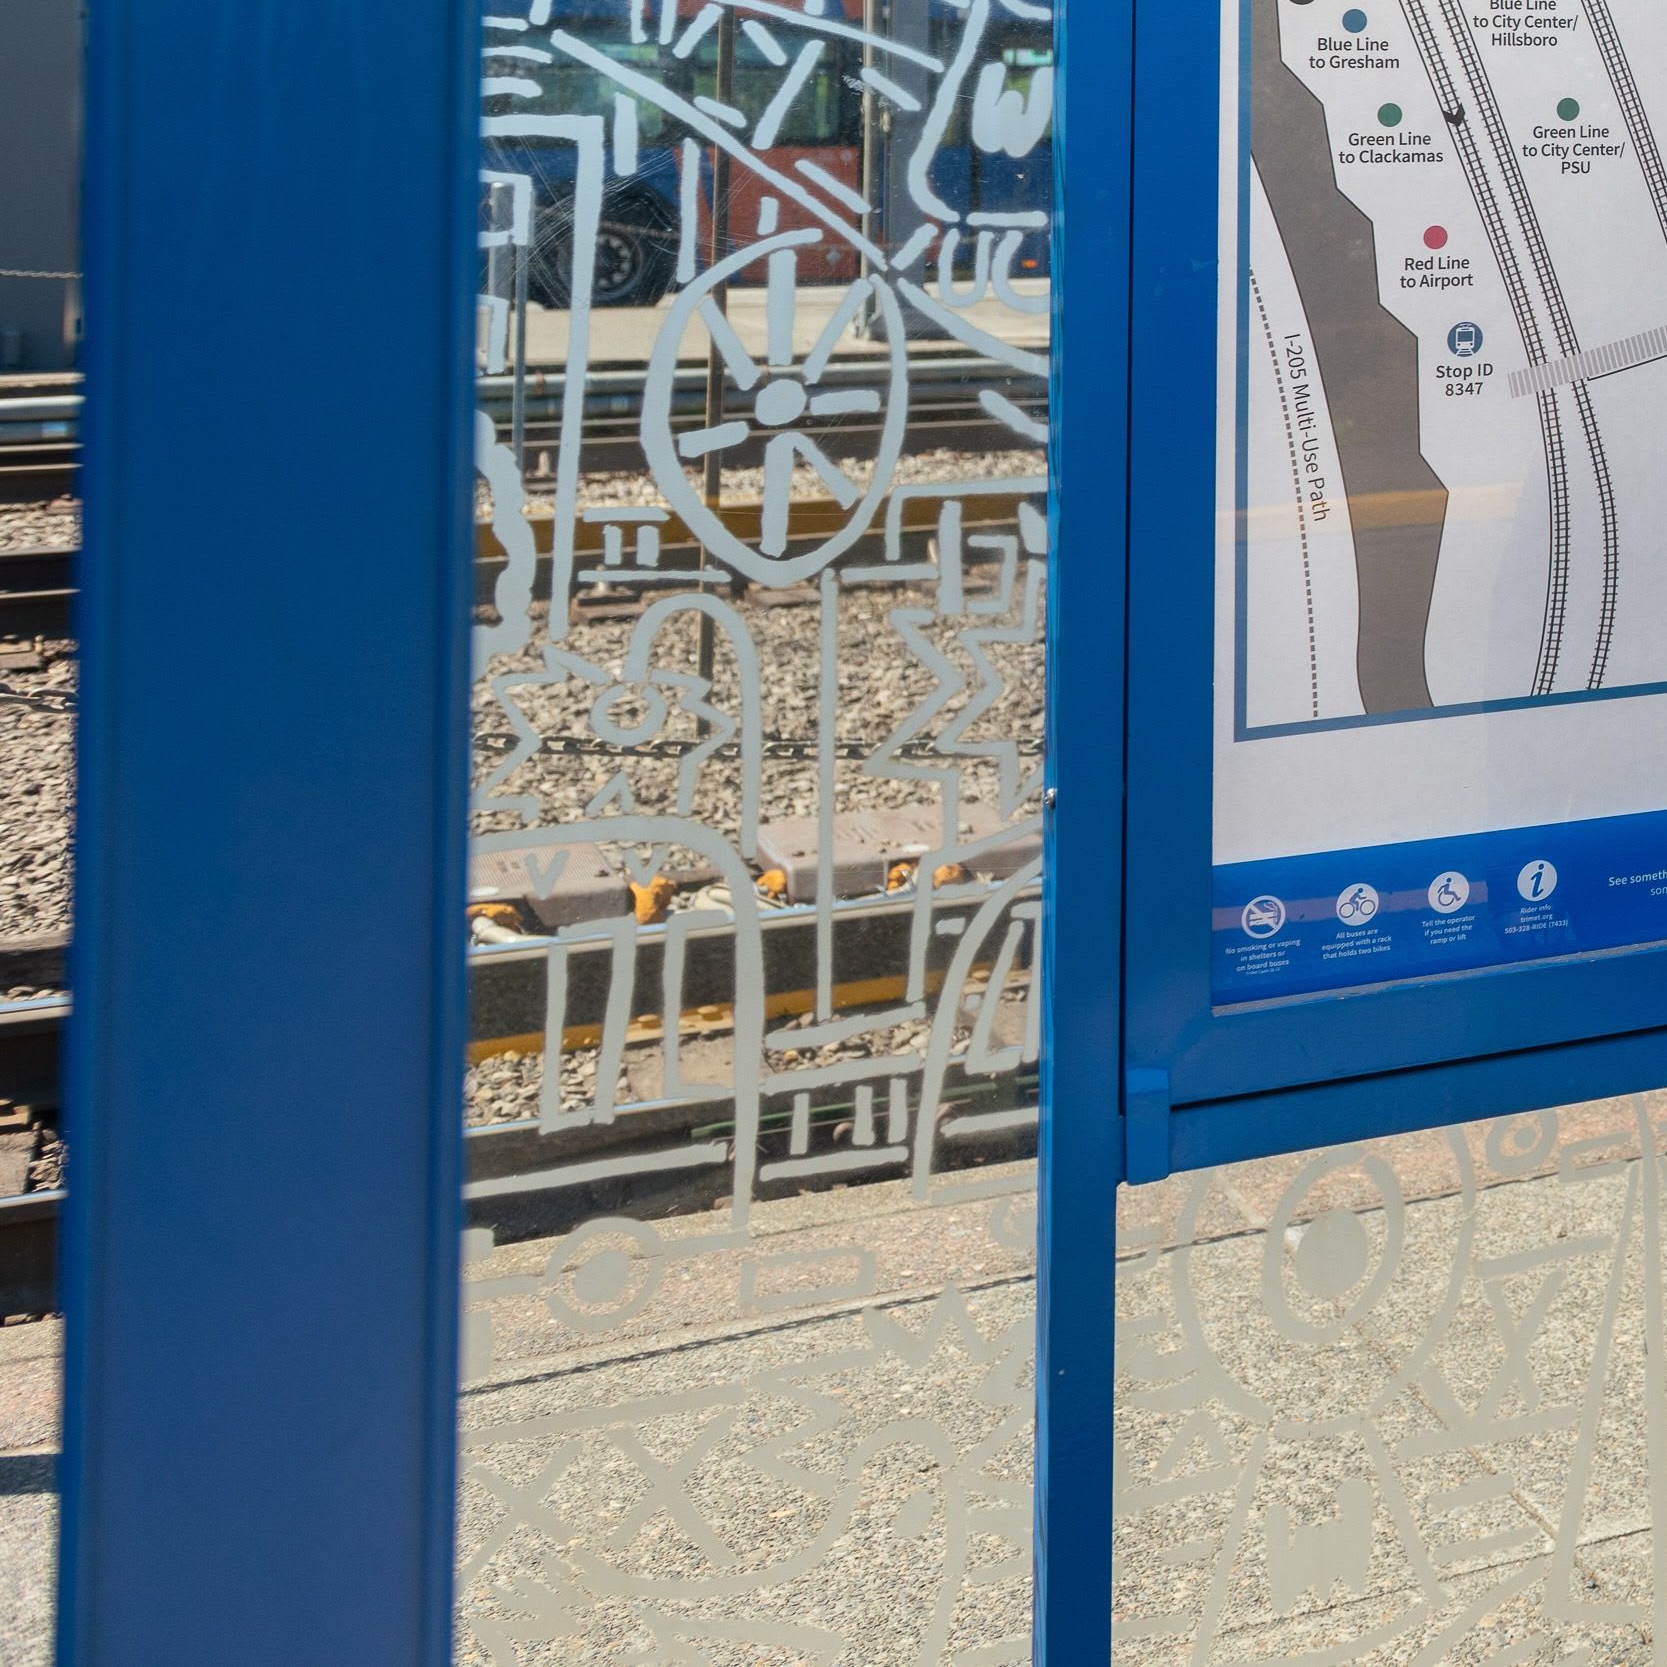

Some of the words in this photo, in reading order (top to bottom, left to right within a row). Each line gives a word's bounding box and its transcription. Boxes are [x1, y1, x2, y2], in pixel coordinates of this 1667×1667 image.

[1473, 16, 1489, 28] to
[1493, 14, 1521, 31] City
[1525, 15, 1579, 31] Center/
[1318, 37, 1352, 51] Blue
[1357, 37, 1389, 51] Line
[1492, 33, 1558, 46] Hillsboro
[1309, 56, 1325, 69] to
[1330, 55, 1399, 69] Gresham
[1349, 133, 1395, 146] Green
[1400, 132, 1431, 145] Line
[1533, 126, 1576, 139] Green
[1580, 125, 1609, 138] Line
[1339, 152, 1355, 164] to
[1360, 149, 1444, 163] Clackamas
[1522, 145, 1538, 157] to
[1542, 143, 1569, 160] City
[1573, 142, 1625, 158] Center/
[1562, 161, 1590, 174] PSU
[1405, 256, 1434, 271] Red
[1439, 256, 1470, 270] Line
[1400, 276, 1416, 288] to
[1419, 274, 1473, 290] Airport
[1284, 334, 1307, 379] I-205
[1436, 366, 1473, 381] Stop
[1478, 364, 1493, 376] ID
[1446, 382, 1483, 397] 8347
[1293, 384, 1319, 473] Multi-Use
[1308, 477, 1331, 522] Path
[1609, 877, 1627, 887] See
